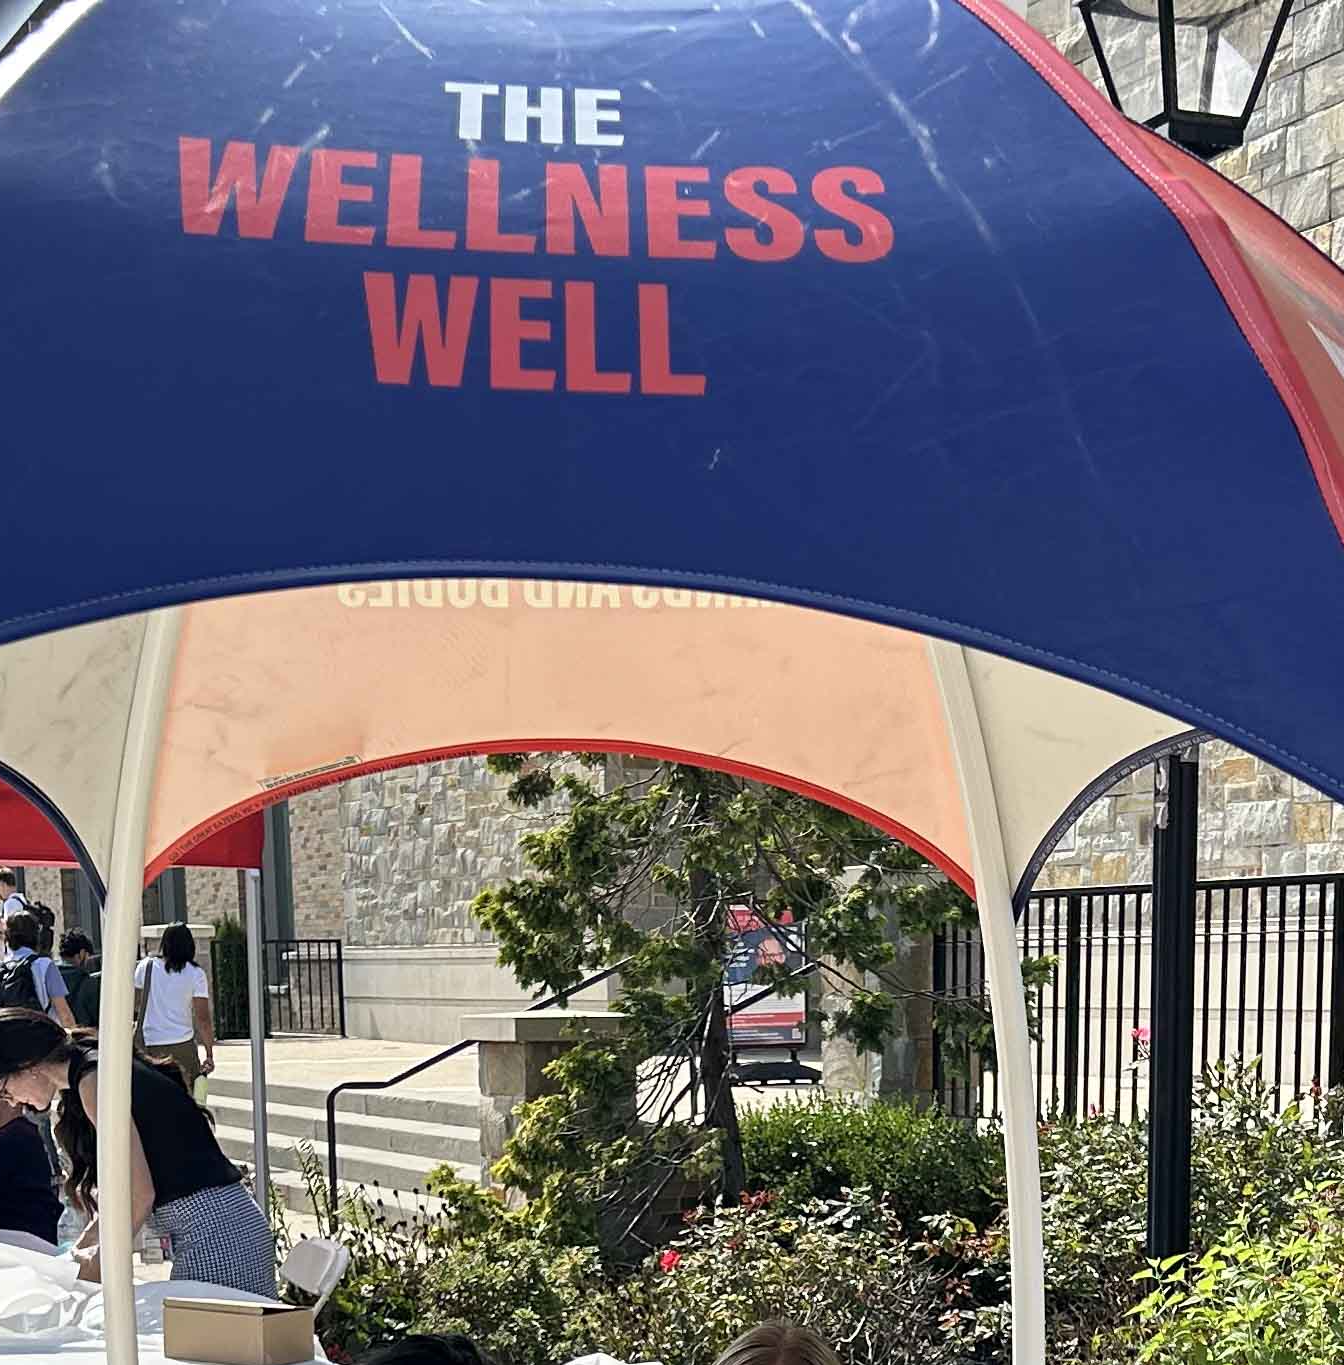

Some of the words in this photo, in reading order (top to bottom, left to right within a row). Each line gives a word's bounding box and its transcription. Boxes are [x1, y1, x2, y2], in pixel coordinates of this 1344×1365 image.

[445, 81, 624, 146] THE
[178, 136, 895, 263] WELLNESS
[363, 271, 707, 396] WELL
